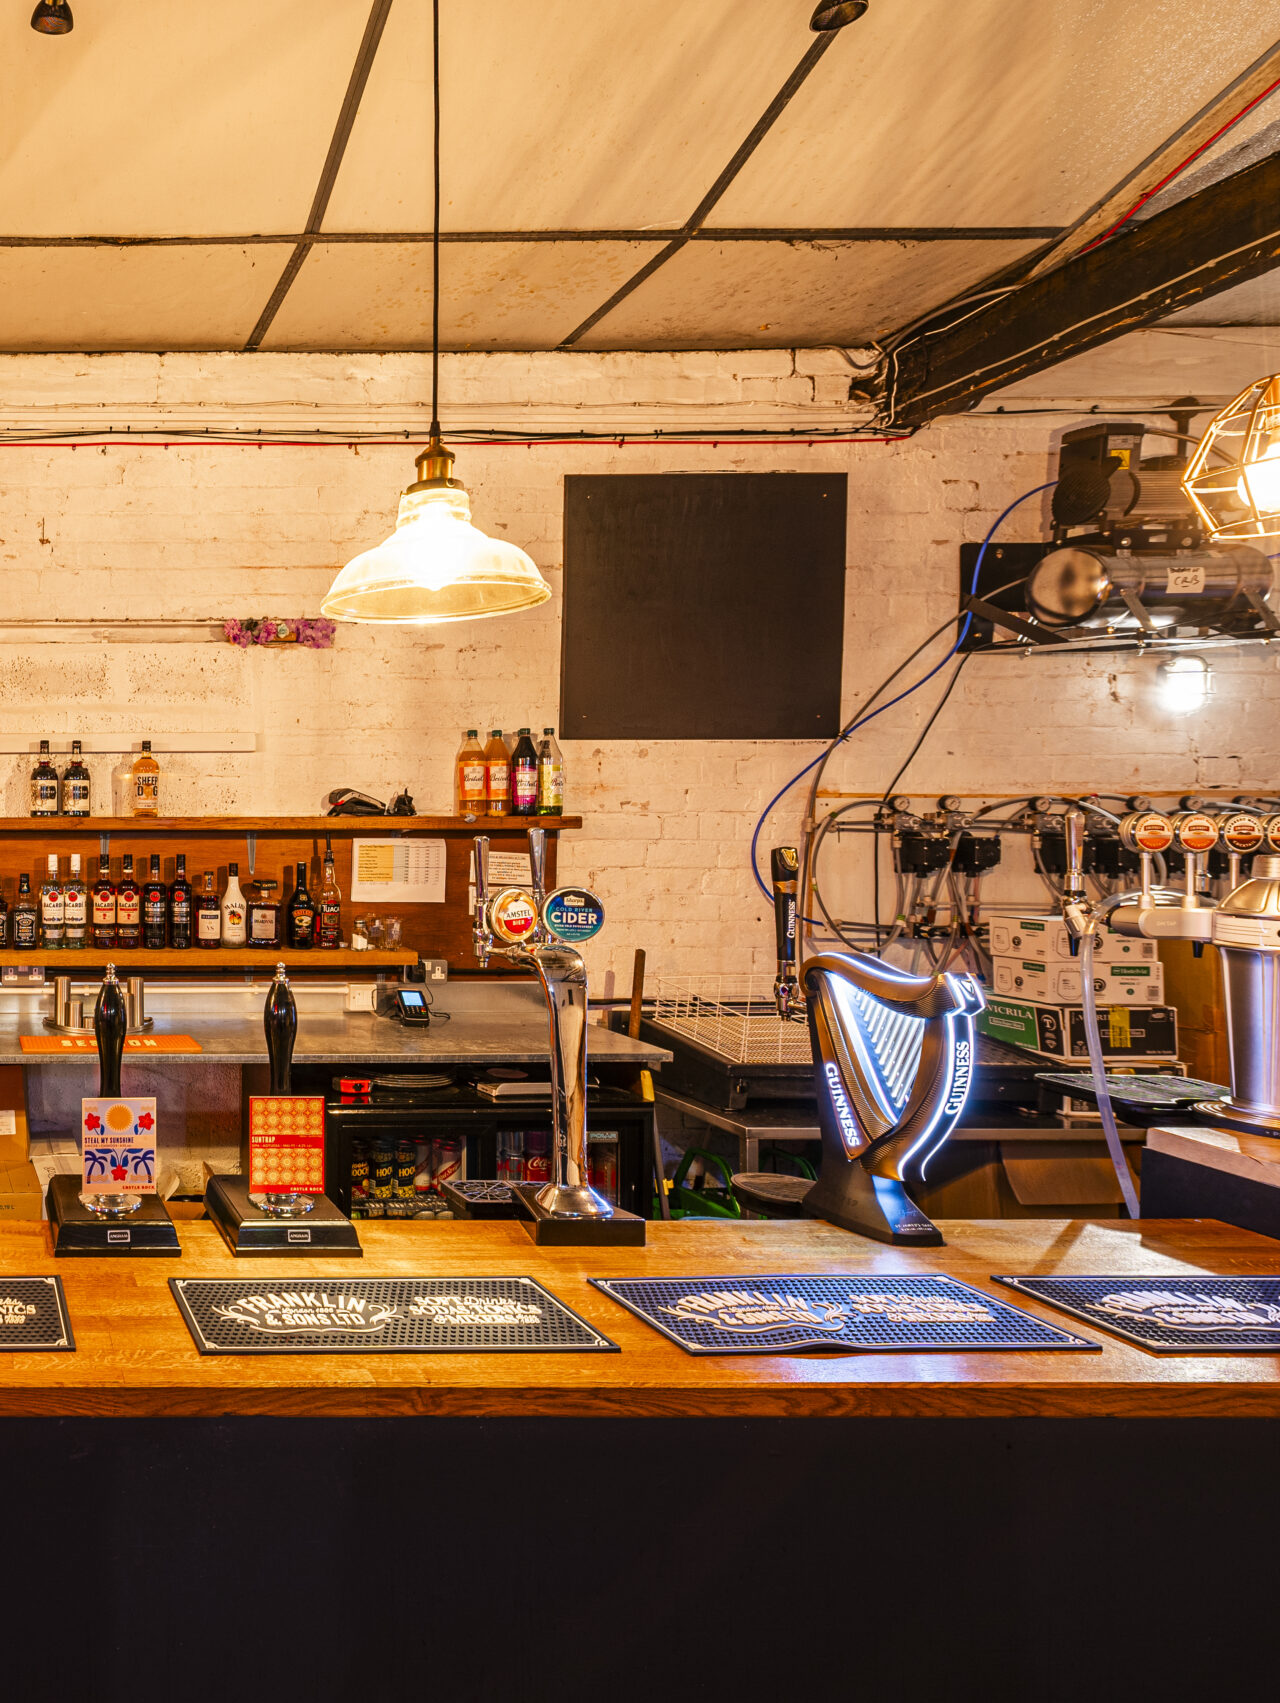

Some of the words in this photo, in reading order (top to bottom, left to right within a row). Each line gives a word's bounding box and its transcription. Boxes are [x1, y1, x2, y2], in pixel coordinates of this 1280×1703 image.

[506, 910, 531, 919] AMSTEL
[550, 912, 598, 925] CIDER
[786, 901, 796, 939] GUINNESS
[986, 1004, 1033, 1020] VICRILA
[61, 1039, 157, 1047] SESON
[944, 1041, 970, 1115] GUINNESS
[825, 1062, 862, 1147] GUINNESS
[110, 1136, 134, 1144] SUNSHINE
[589, 1132, 617, 1140] POLAR
[236, 1291, 367, 1315] FRANKLIN
[414, 1296, 464, 1306] SOFT
[677, 1290, 809, 1314] FRANKLIN
[469, 1304, 543, 1315] TONICS
[264, 1313, 283, 1326] &
[281, 1313, 332, 1326] SONS
[330, 1313, 366, 1326] LTD
[444, 1314, 520, 1325] MIXERS
